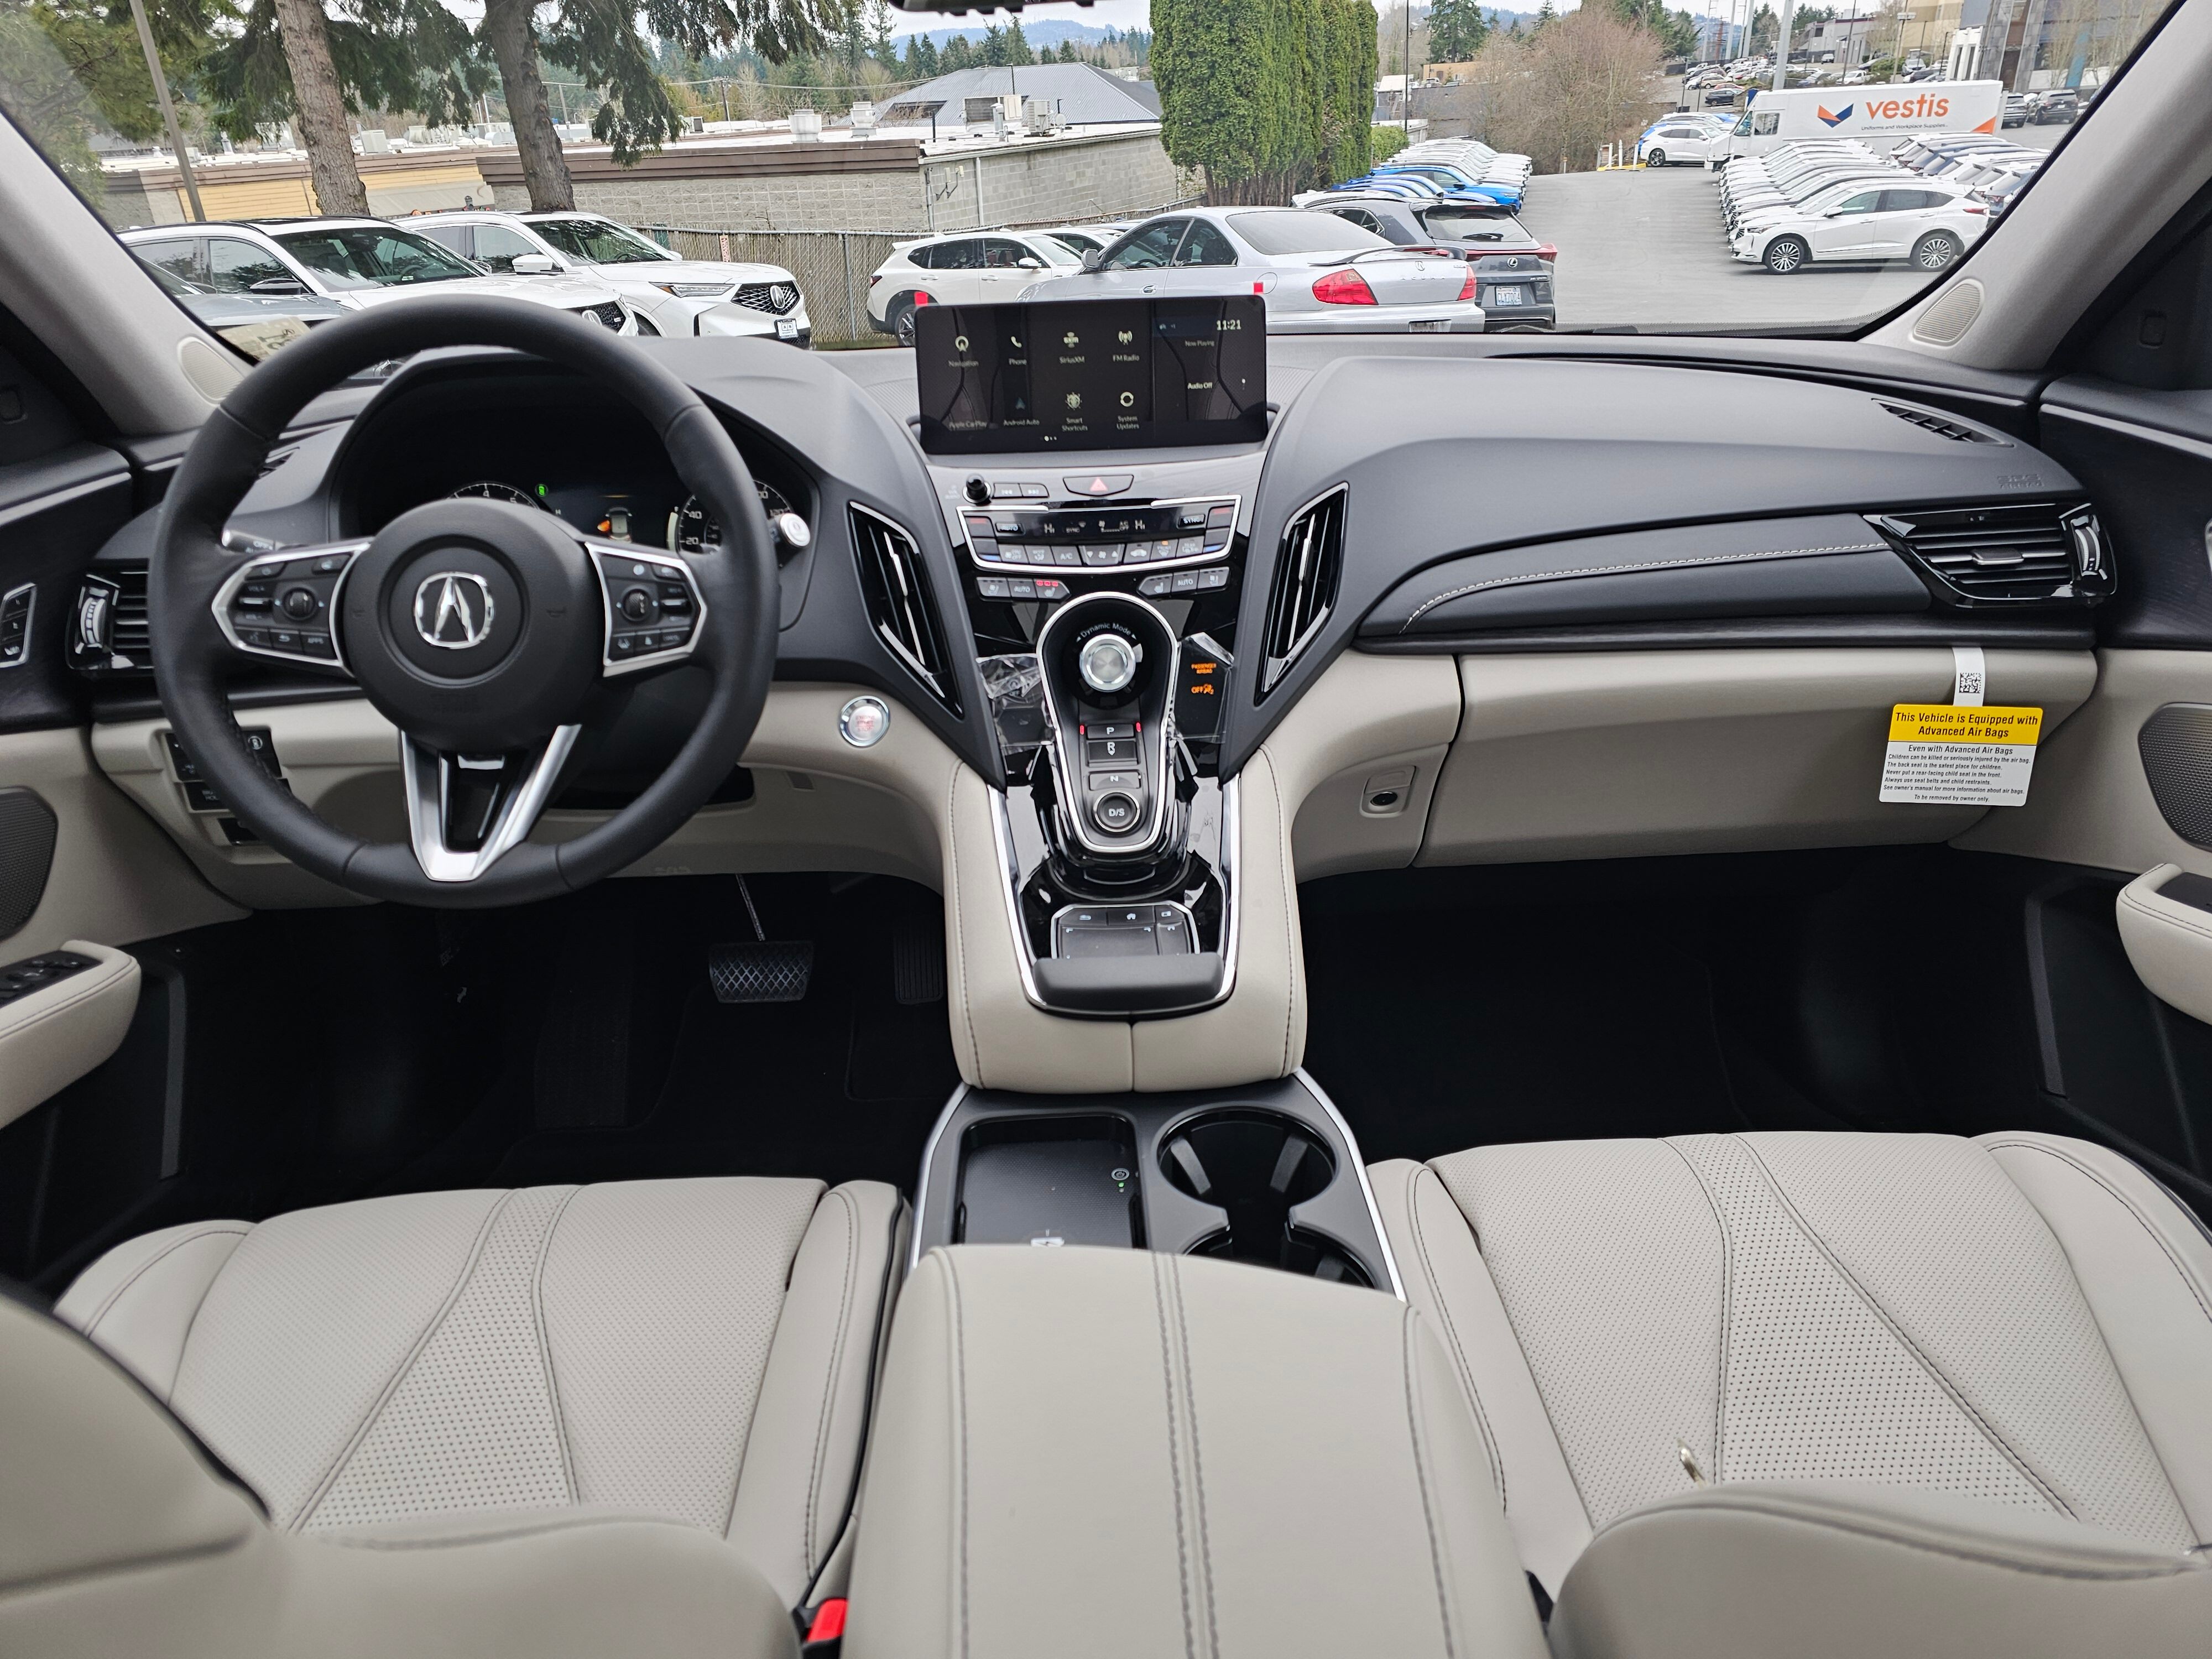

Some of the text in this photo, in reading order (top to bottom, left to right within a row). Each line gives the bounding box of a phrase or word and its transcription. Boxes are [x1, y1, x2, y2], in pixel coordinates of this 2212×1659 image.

[1865, 93, 1949, 120] vestis
[1217, 319, 1242, 331] 11:21
[1197, 339, 1215, 347] Playing
[1059, 355, 1086, 364] SiriusXM
[1113, 353, 1140, 362] FM Radio
[948, 359, 979, 368] Navigation
[1187, 382, 1203, 390] Audio
[948, 420, 988, 429] Apple CarPlay
[1061, 424, 1089, 432] Shortcuts
[1116, 422, 1140, 431] Updates
[685, 536, 699, 545] 20
[1177, 578, 1194, 587] AUTO
[1080, 622, 1132, 638] Dynamic Mode
[1191, 686, 1204, 694] OFF
[1896, 712, 2038, 726] This Vehicle is Equipped with
[1107, 727, 1115, 735] P
[1918, 726, 2009, 739] Advanced Air Bags
[1107, 742, 1115, 750] R
[1944, 745, 1980, 754] Advanced
[1995, 747, 2013, 756] Bags
[1108, 808, 1125, 817] D/S
